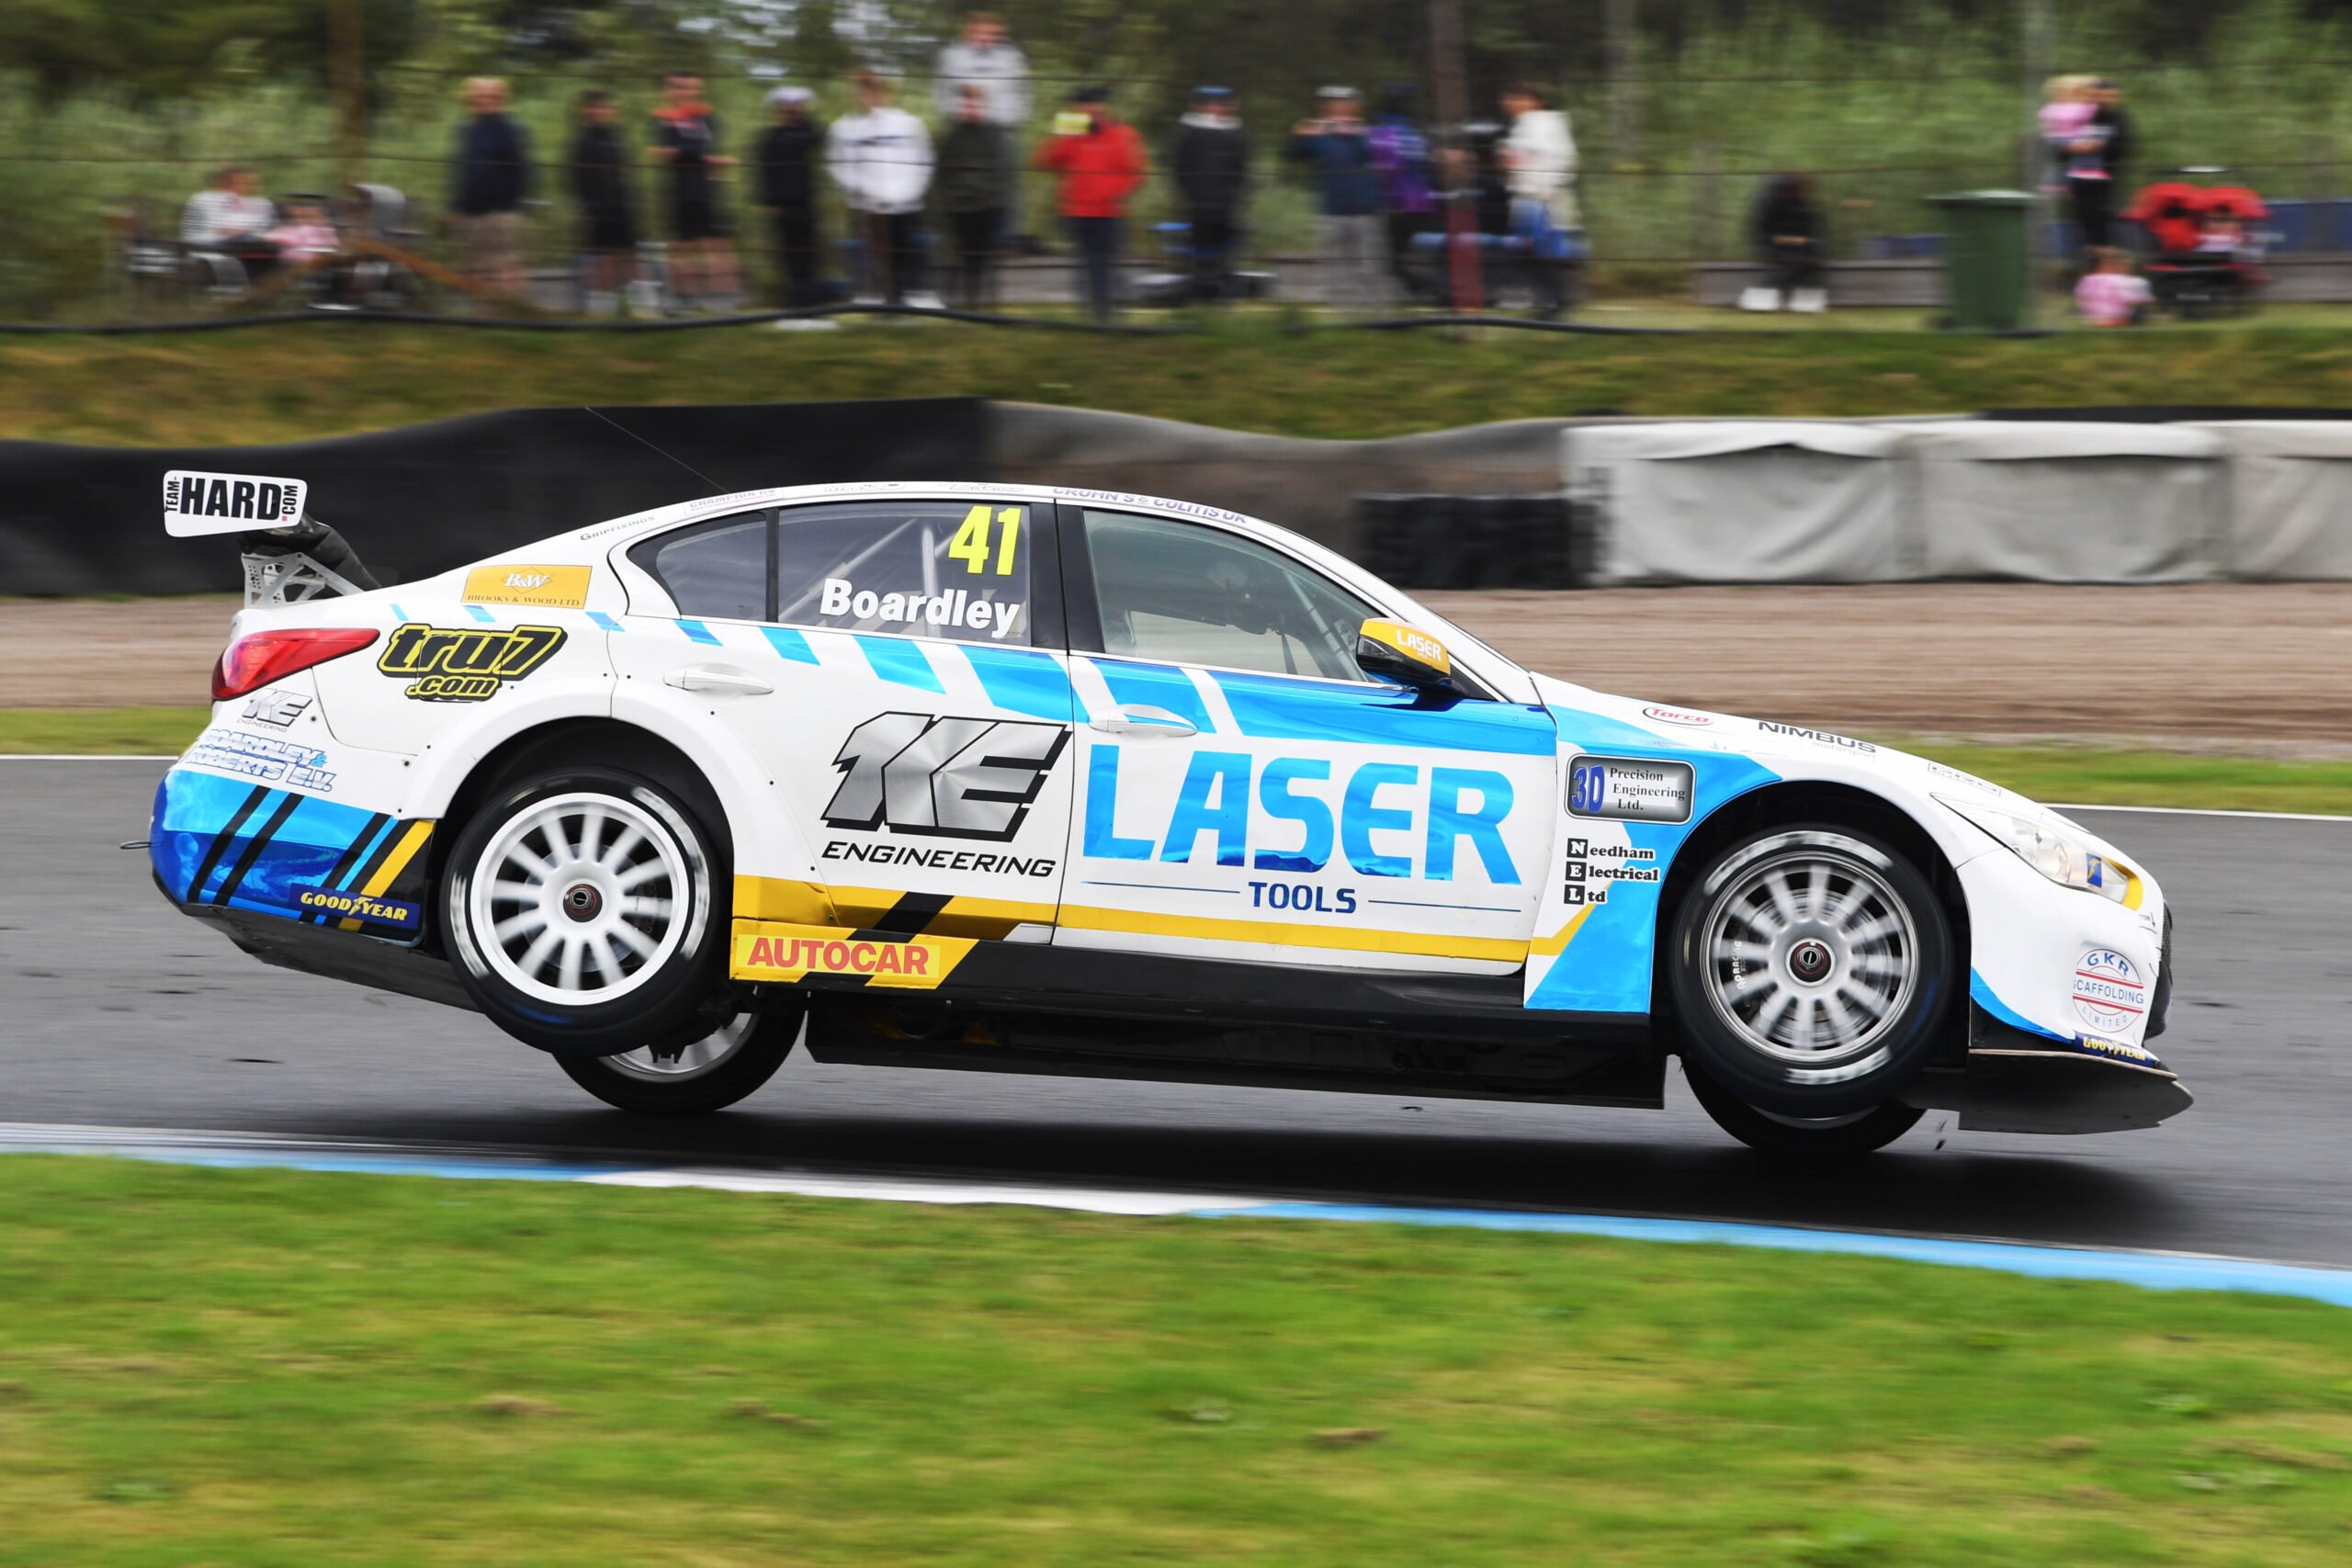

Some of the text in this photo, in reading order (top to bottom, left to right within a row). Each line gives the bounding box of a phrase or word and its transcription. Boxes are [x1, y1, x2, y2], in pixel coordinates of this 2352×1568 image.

[948, 505, 1021, 576] 41
[468, 594, 509, 603] BROOKS
[524, 596, 557, 605] WOOD
[560, 598, 580, 606] LTD
[820, 578, 1020, 639] Boardley
[1396, 628, 1442, 662] LASER
[1758, 721, 1876, 753] NIMBUS
[1571, 764, 1605, 813] 3D
[1610, 767, 1663, 782] Precision
[1612, 783, 1686, 801] Engineering
[1617, 798, 1644, 811] Ltd.
[1083, 743, 1522, 886] LASER
[821, 841, 1057, 878] ENGINEERING
[1566, 837, 1654, 860] Needham
[1565, 861, 1659, 882] Electrical
[300, 891, 408, 921] GOODYEAR
[1248, 881, 1357, 915] TOOLS
[1564, 884, 1606, 906] Ltd
[747, 937, 929, 976] AUTOCAR
[2086, 952, 2130, 976] GKR
[2082, 1005, 2128, 1027] LIMITED
